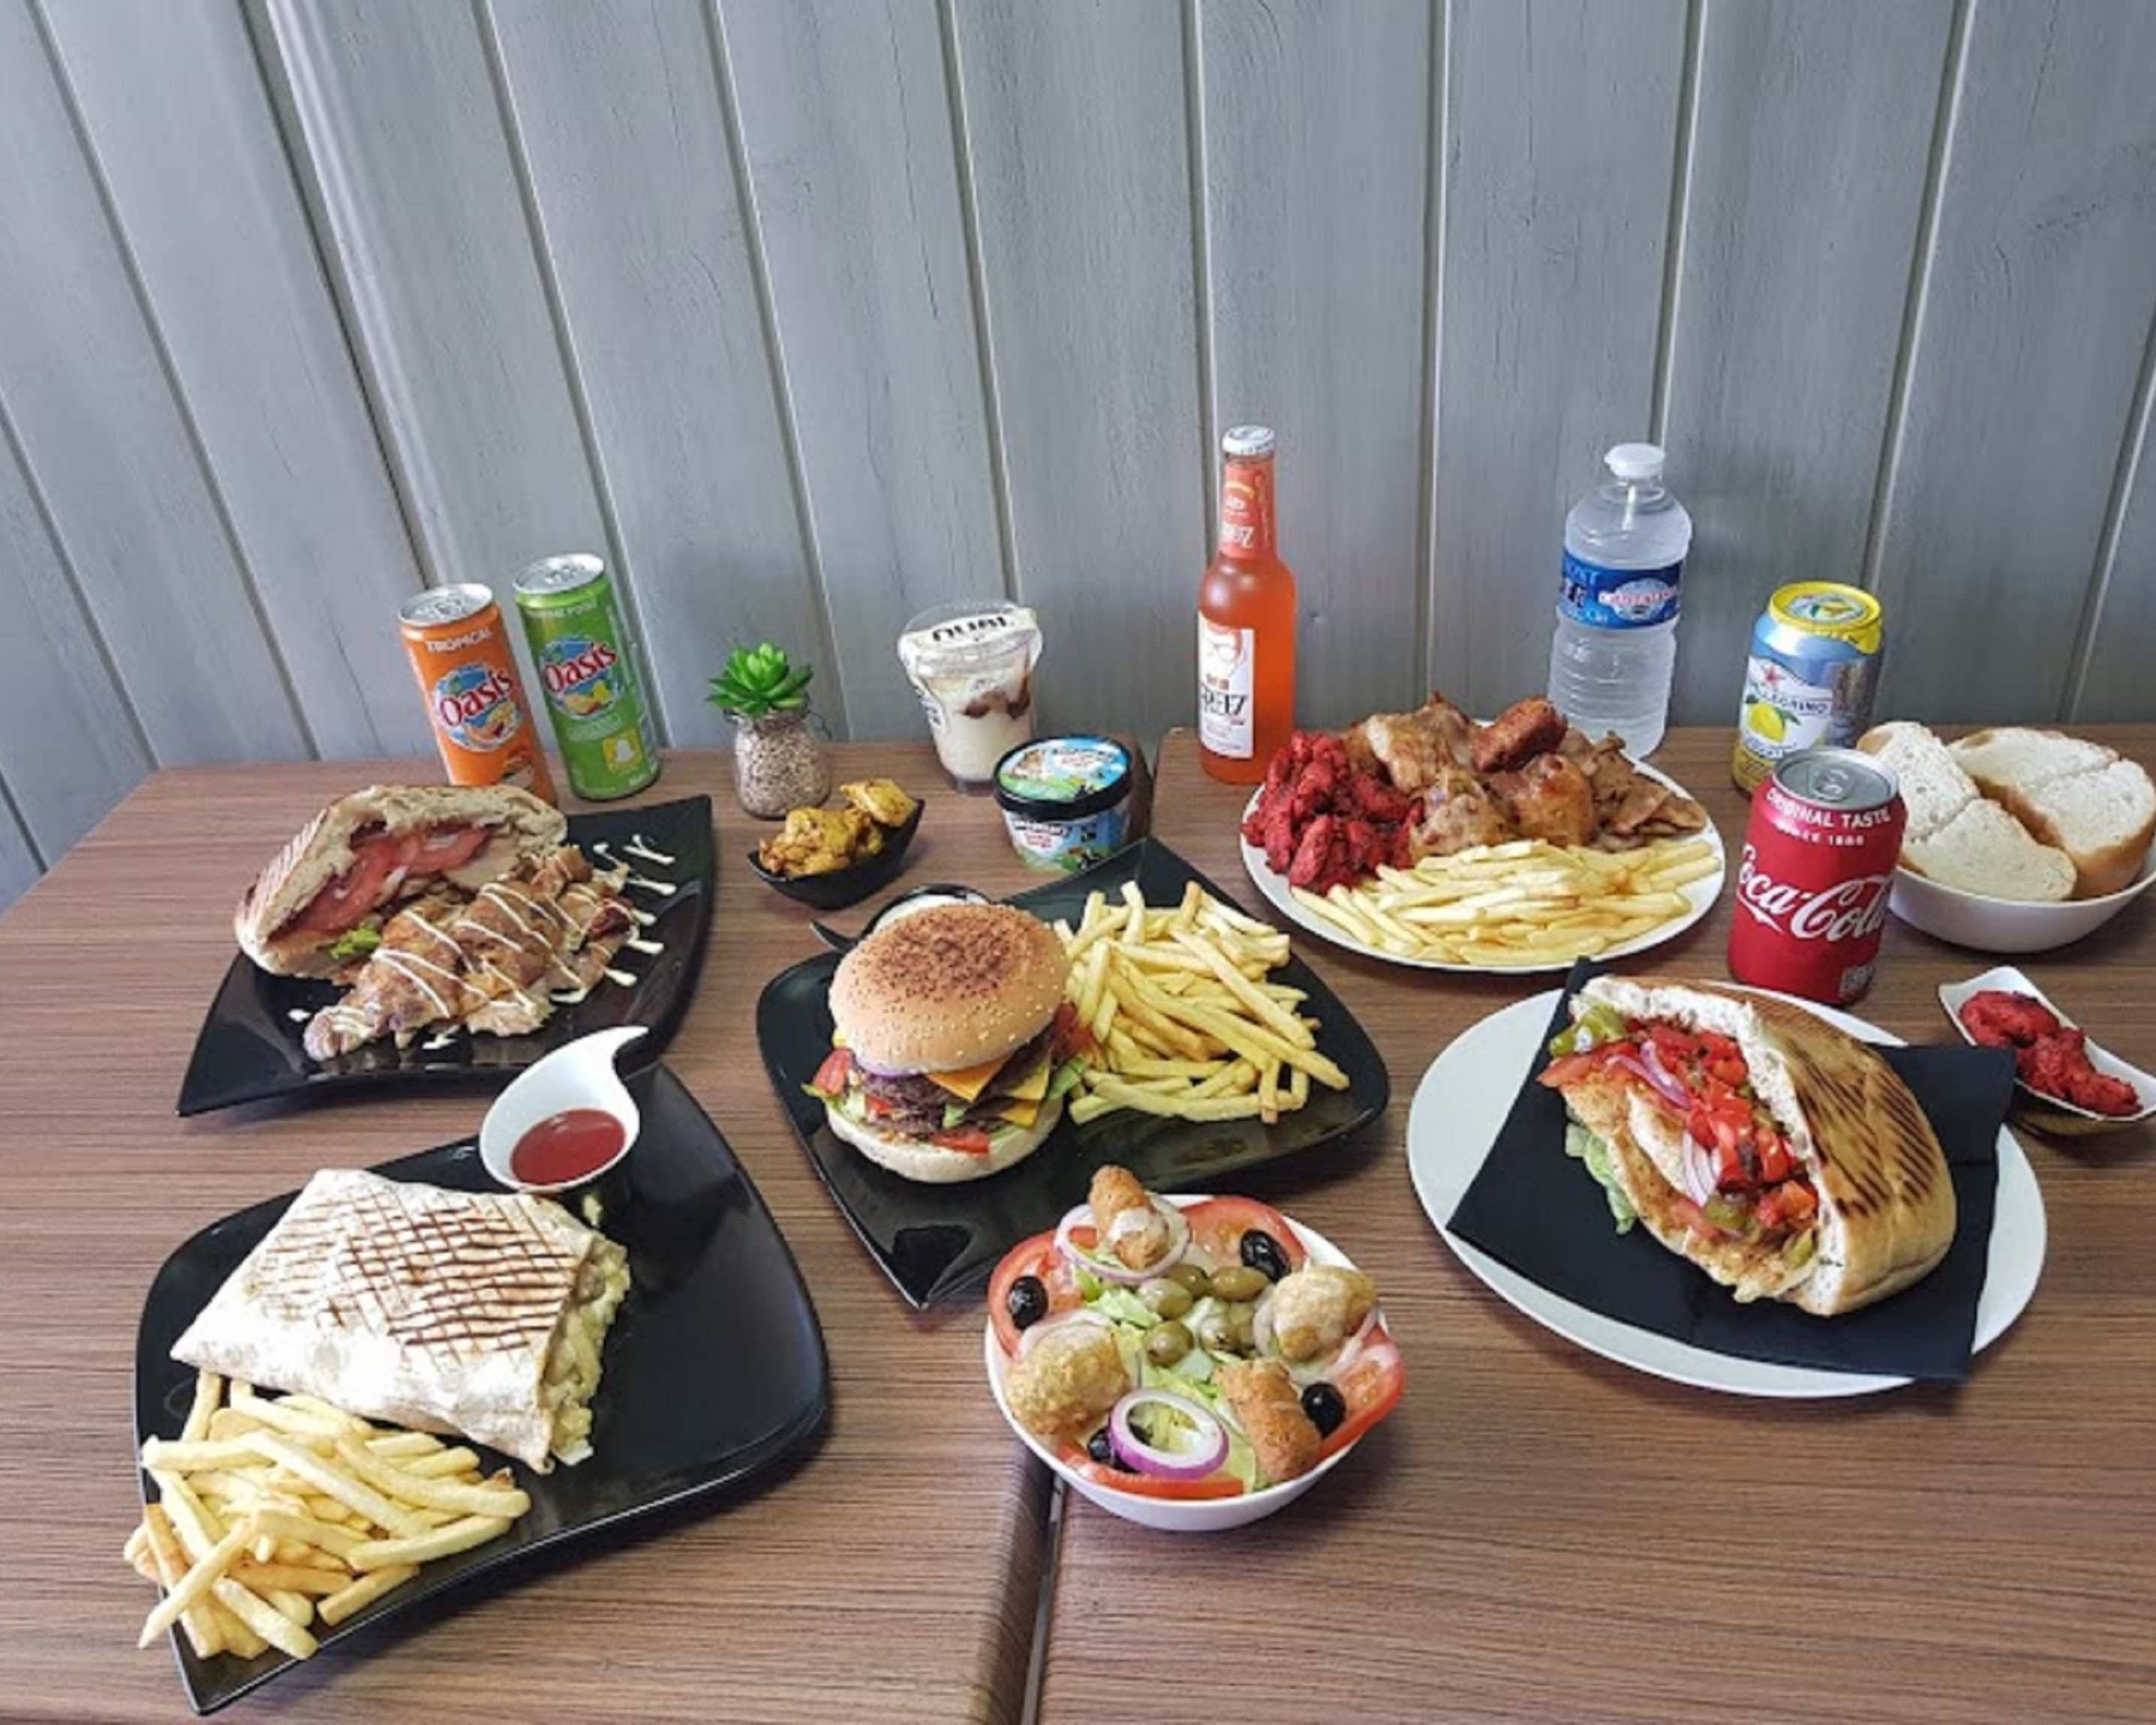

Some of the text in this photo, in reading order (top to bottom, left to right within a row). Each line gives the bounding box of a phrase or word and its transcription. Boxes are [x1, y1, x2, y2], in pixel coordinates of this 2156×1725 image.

[426, 627, 492, 653] TROPICAL
[543, 641, 618, 693] Oasis
[439, 669, 514, 727] Oasis
[1765, 787, 1892, 830] ORIGINAL TASTE
